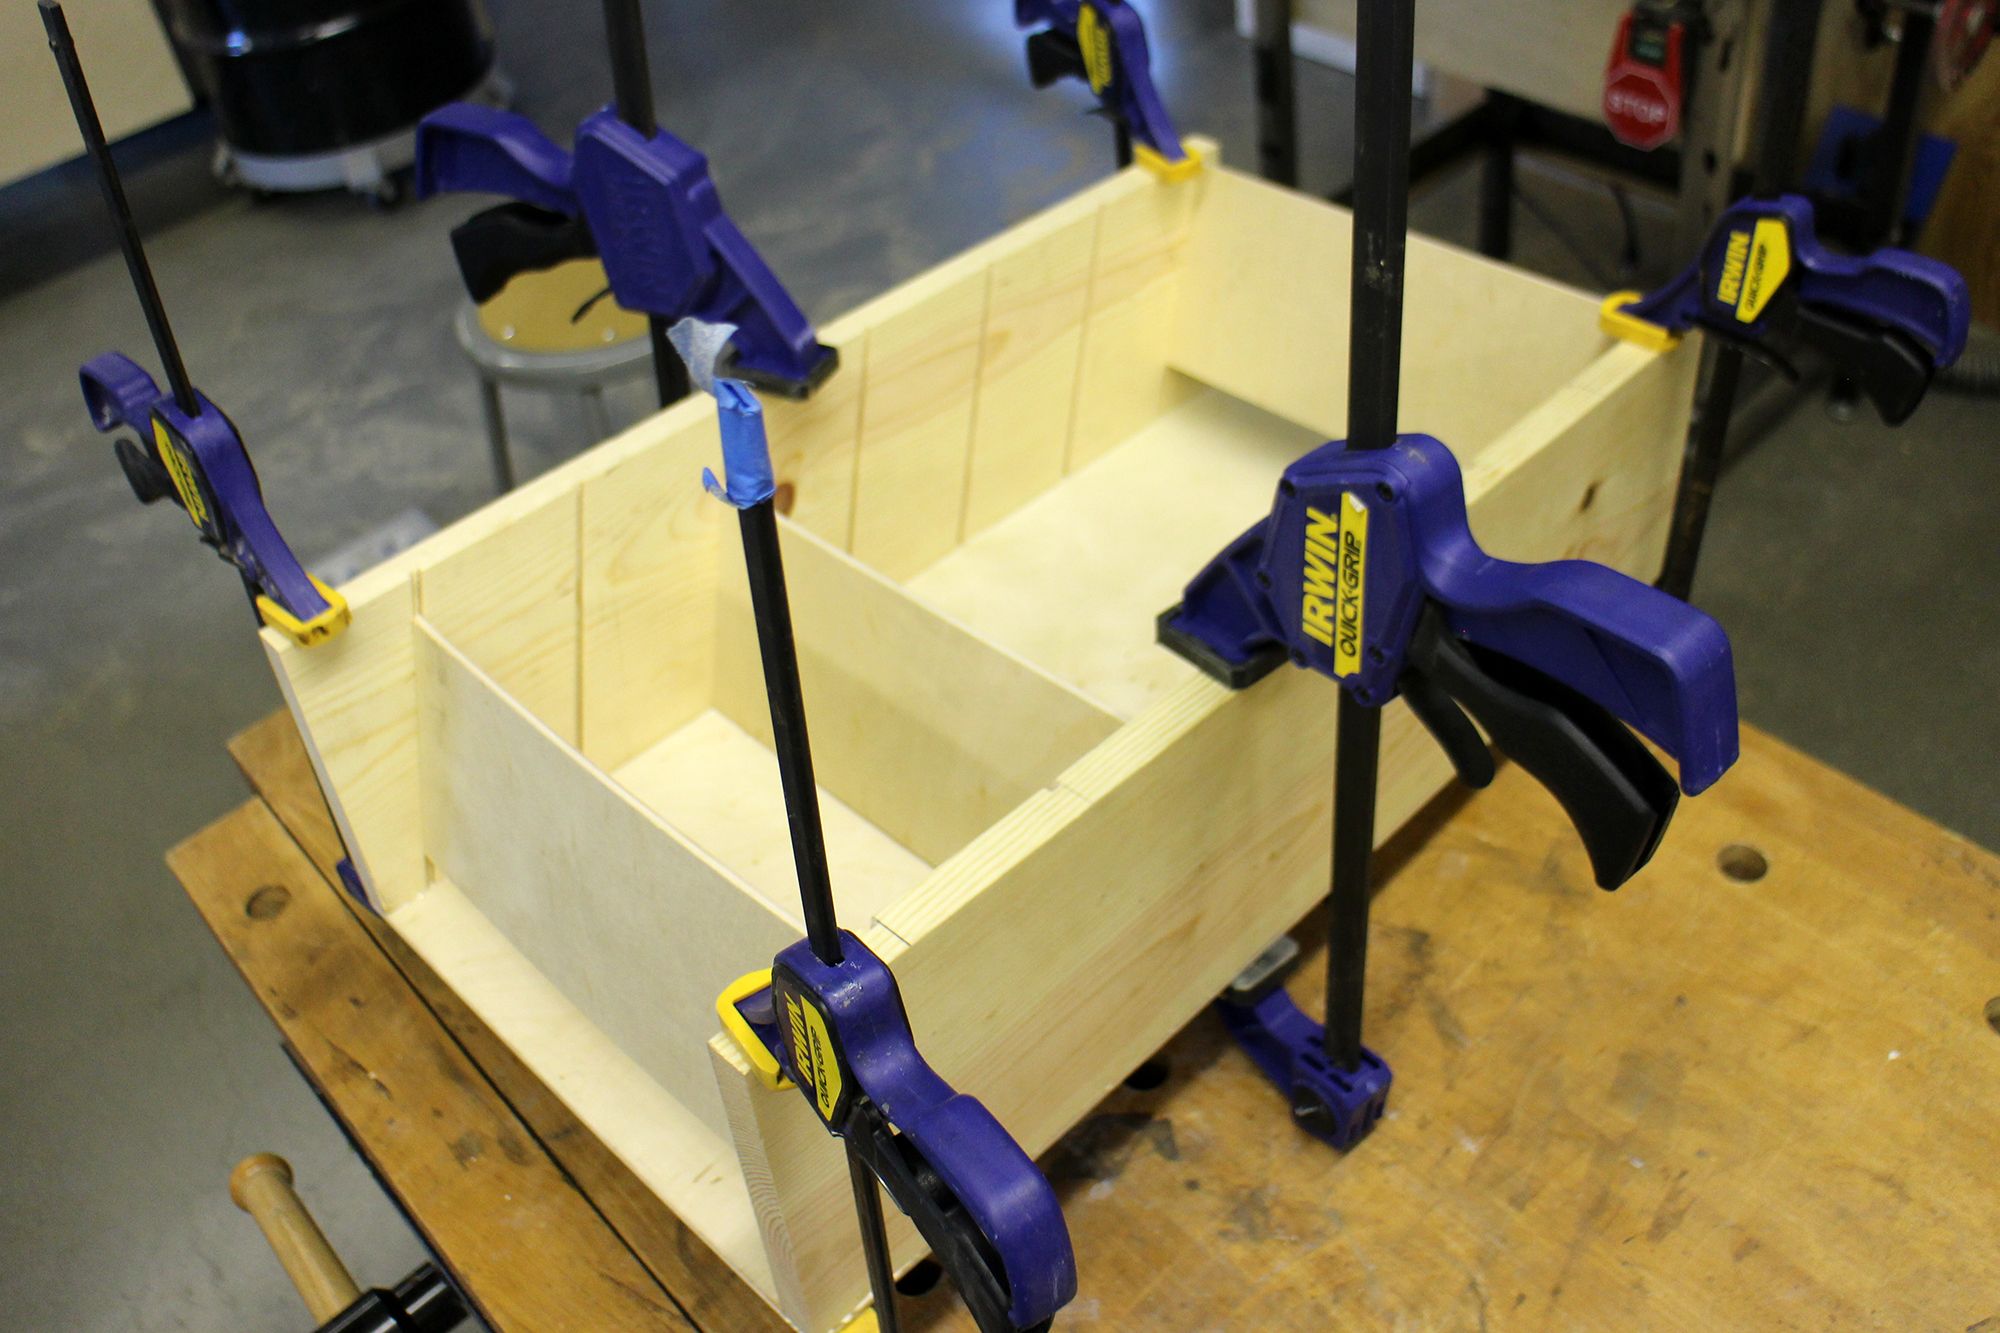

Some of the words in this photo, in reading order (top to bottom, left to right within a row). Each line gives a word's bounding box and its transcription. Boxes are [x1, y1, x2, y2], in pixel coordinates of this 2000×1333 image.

[1607, 91, 1665, 124] STOP
[1717, 230, 1750, 305] IRWIN
[1302, 506, 1338, 648] IRWIN
[784, 991, 814, 1087] IRWIN
